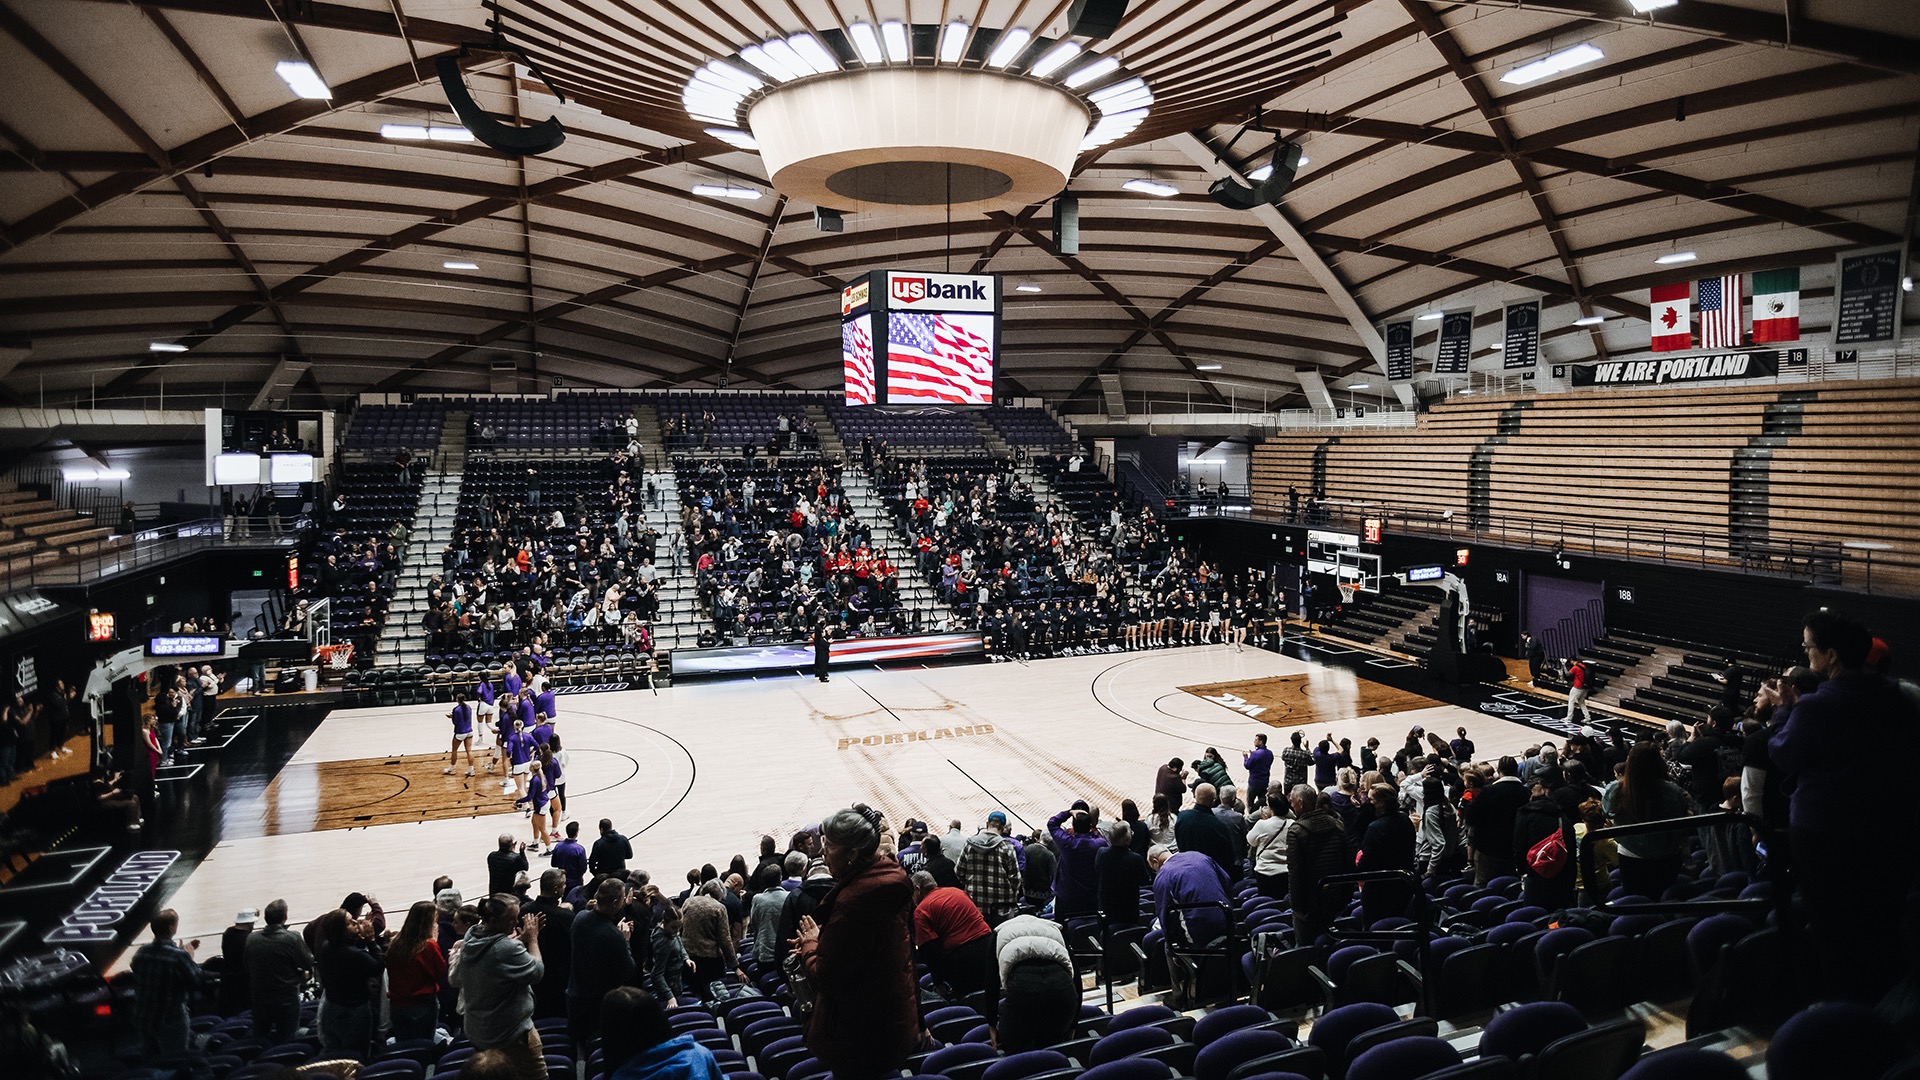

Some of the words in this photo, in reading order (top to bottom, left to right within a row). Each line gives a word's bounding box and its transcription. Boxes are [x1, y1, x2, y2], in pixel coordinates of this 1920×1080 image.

[1792, 351, 1803, 362] 18
[1555, 367, 1562, 376] 18
[1594, 363, 1623, 382] WE
[1622, 361, 1656, 382] ARE
[1656, 354, 1750, 383] PORTLAND
[1365, 527, 1378, 541] 30
[1496, 572, 1507, 582] 18A
[91, 615, 114, 626] 10:00
[93, 626, 110, 637] 30
[837, 724, 995, 751] PORTLAND
[42, 850, 182, 943] PORTLAND
